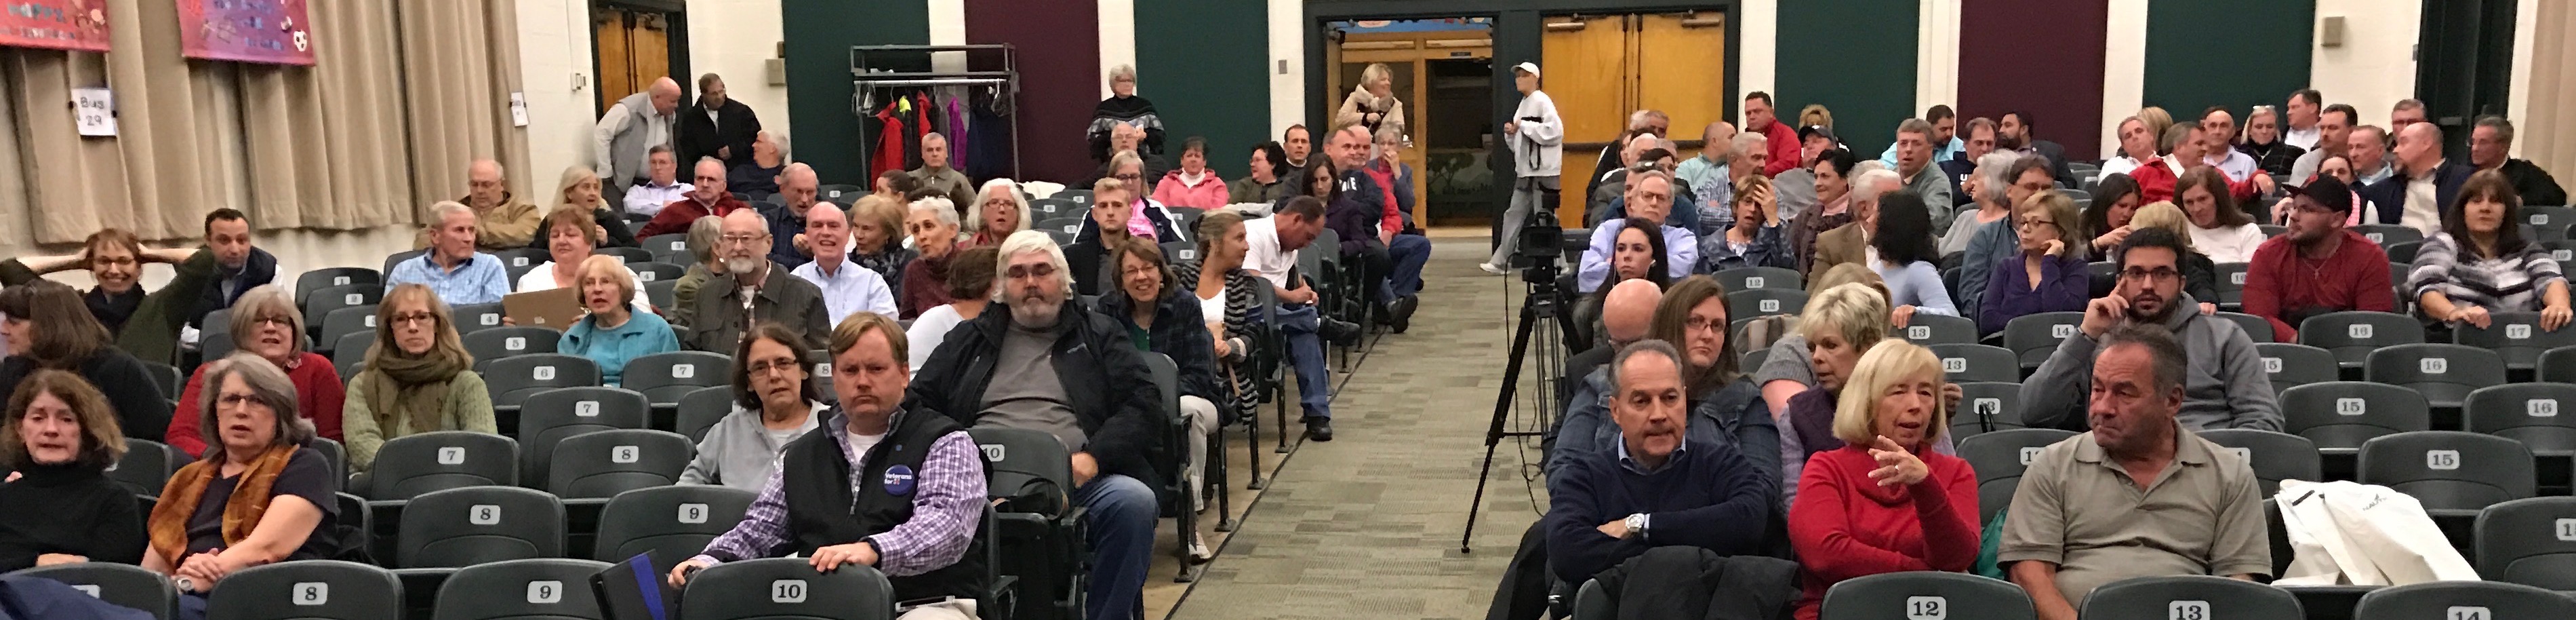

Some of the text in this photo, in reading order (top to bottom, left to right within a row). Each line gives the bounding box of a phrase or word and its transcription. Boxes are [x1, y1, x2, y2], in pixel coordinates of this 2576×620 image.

[80, 96, 104, 109] Bus
[85, 115, 102, 125] 29
[1911, 329, 1926, 338] 13
[2354, 327, 2368, 336] 16
[2511, 328, 2526, 336] 17
[822, 366, 828, 374] 8
[1947, 361, 1961, 369] 13
[2262, 361, 2277, 370] 15
[2426, 361, 2442, 370] 16
[584, 404, 591, 413] 7
[2343, 402, 2360, 412] 15
[2534, 403, 2552, 413] 16
[447, 450, 456, 461] 7
[622, 450, 630, 459] 8
[2434, 454, 2453, 465] 15
[481, 508, 490, 520] 8
[689, 507, 699, 519] 9
[305, 587, 317, 600] 8
[540, 585, 551, 599] 9
[778, 585, 800, 598] 10
[1913, 601, 1939, 616] 12
[2177, 606, 2202, 620] 13
